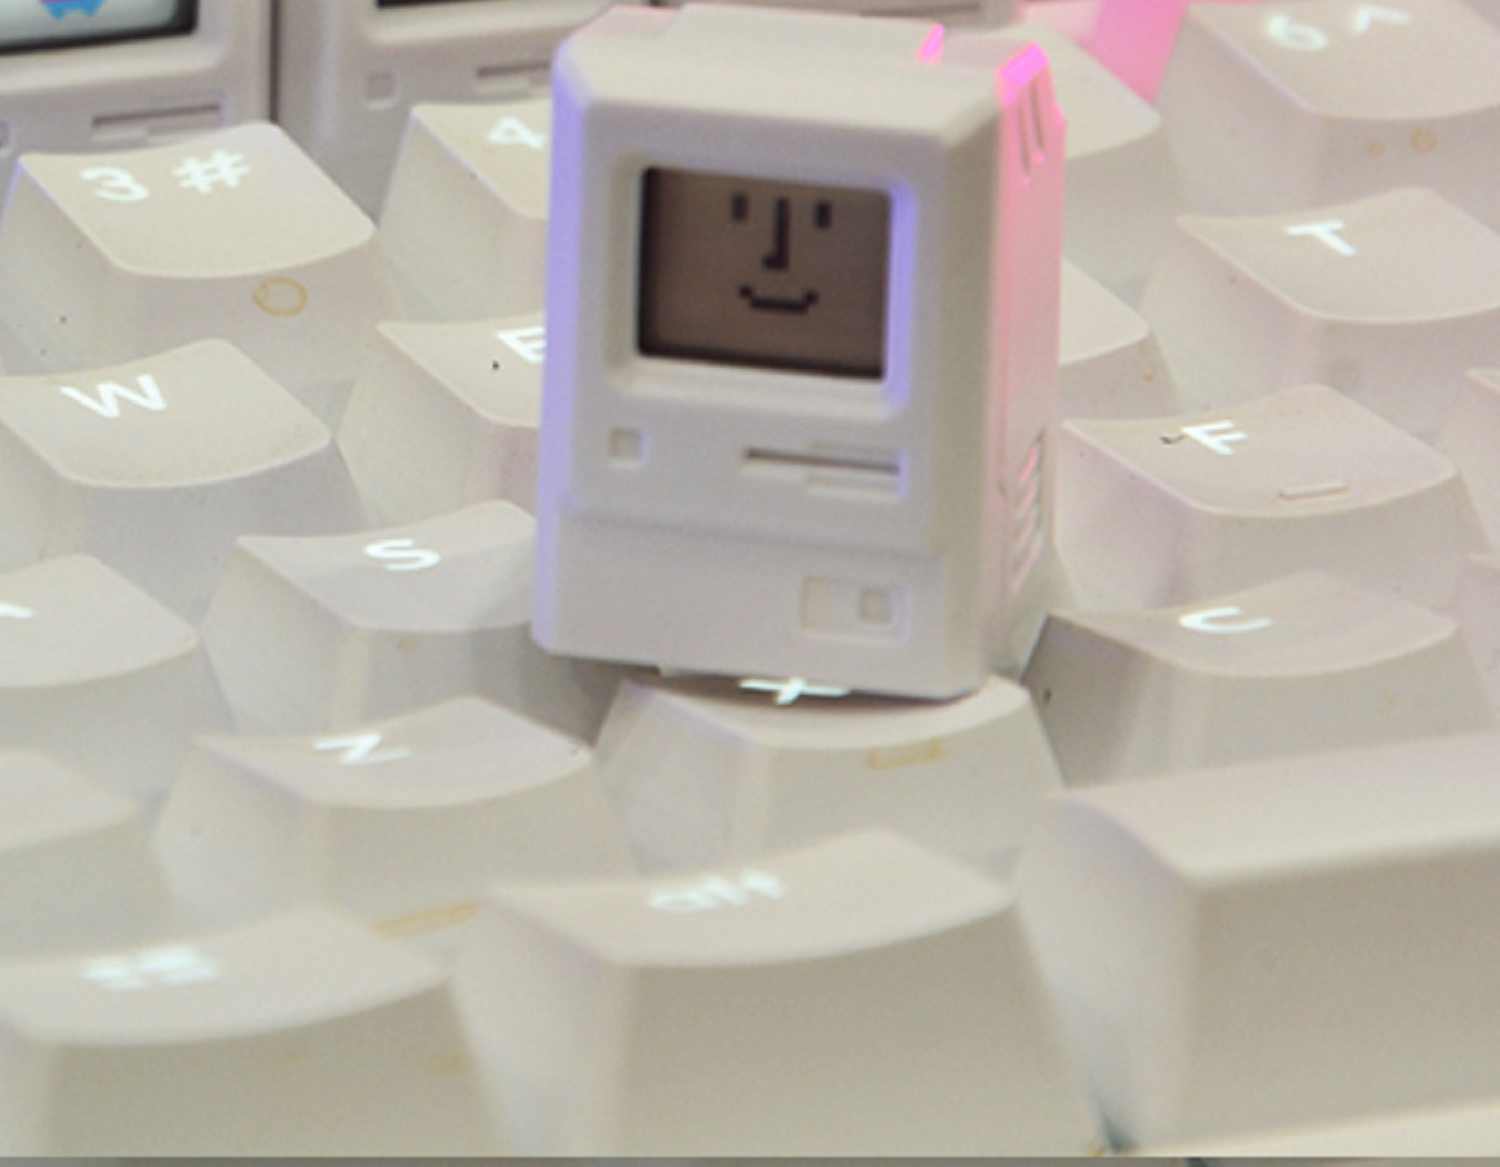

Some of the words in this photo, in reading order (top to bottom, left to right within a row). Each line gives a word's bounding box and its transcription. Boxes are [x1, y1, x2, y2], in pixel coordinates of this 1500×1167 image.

[1267, 13, 1329, 51] 6
[81, 167, 149, 201] 3
[1288, 220, 1356, 256] T
[496, 326, 547, 365] E
[60, 374, 166, 418] W
[1182, 421, 1248, 455] F
[365, 538, 440, 570] S
[1180, 607, 1270, 633] C
